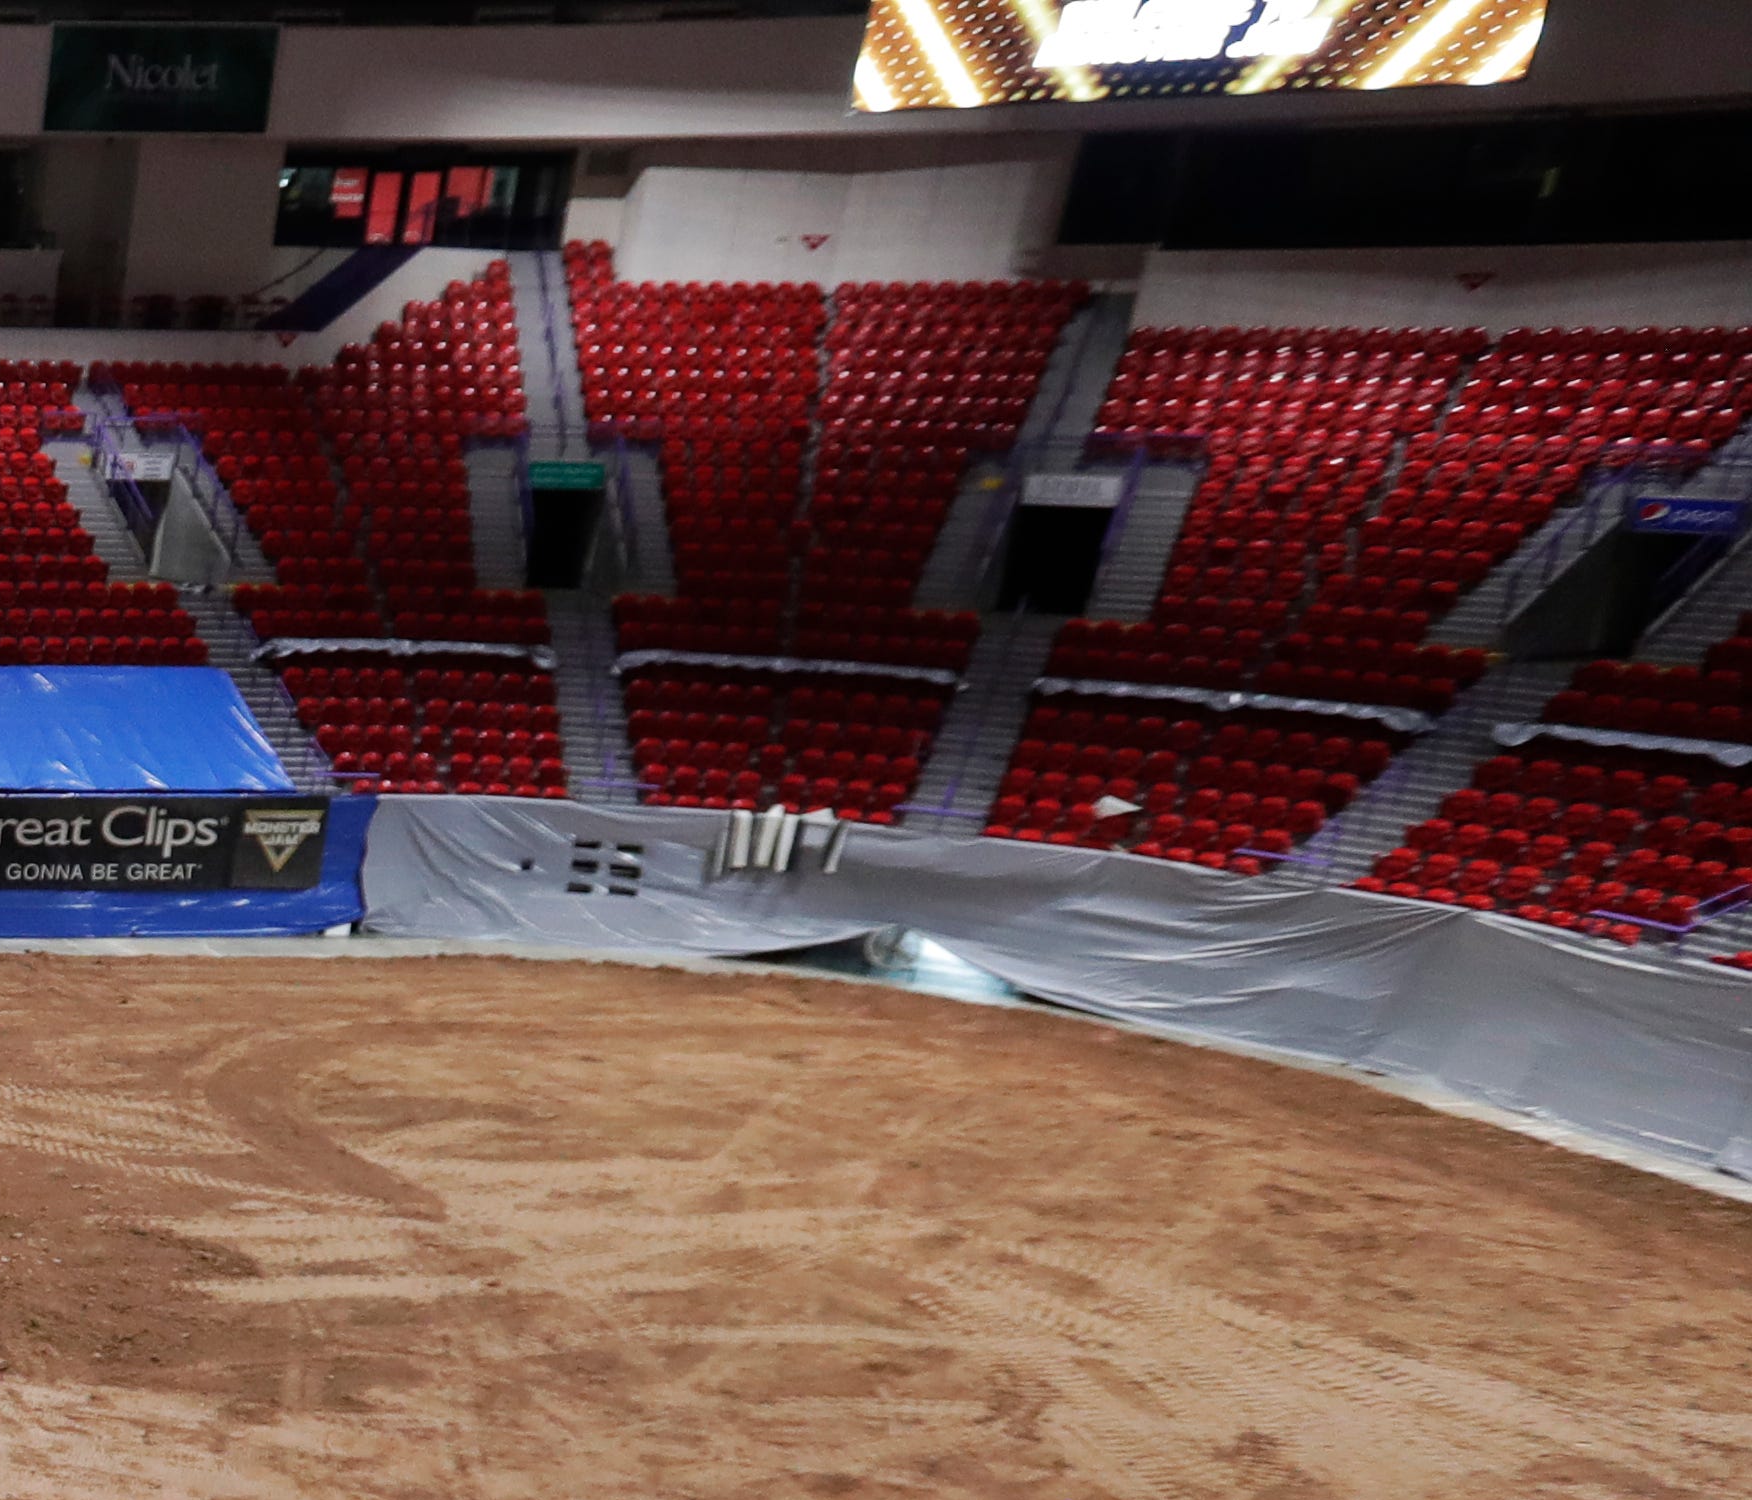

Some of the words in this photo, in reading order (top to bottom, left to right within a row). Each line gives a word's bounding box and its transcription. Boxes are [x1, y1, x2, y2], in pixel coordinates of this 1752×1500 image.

[104, 53, 219, 92] Nicolet
[102, 806, 218, 858] Clips
[243, 821, 320, 835] MONSTER
[264, 835, 299, 846] JAM
[8, 863, 83, 882] GONNA
[92, 863, 119, 882] BE
[127, 863, 198, 882] GREAT
